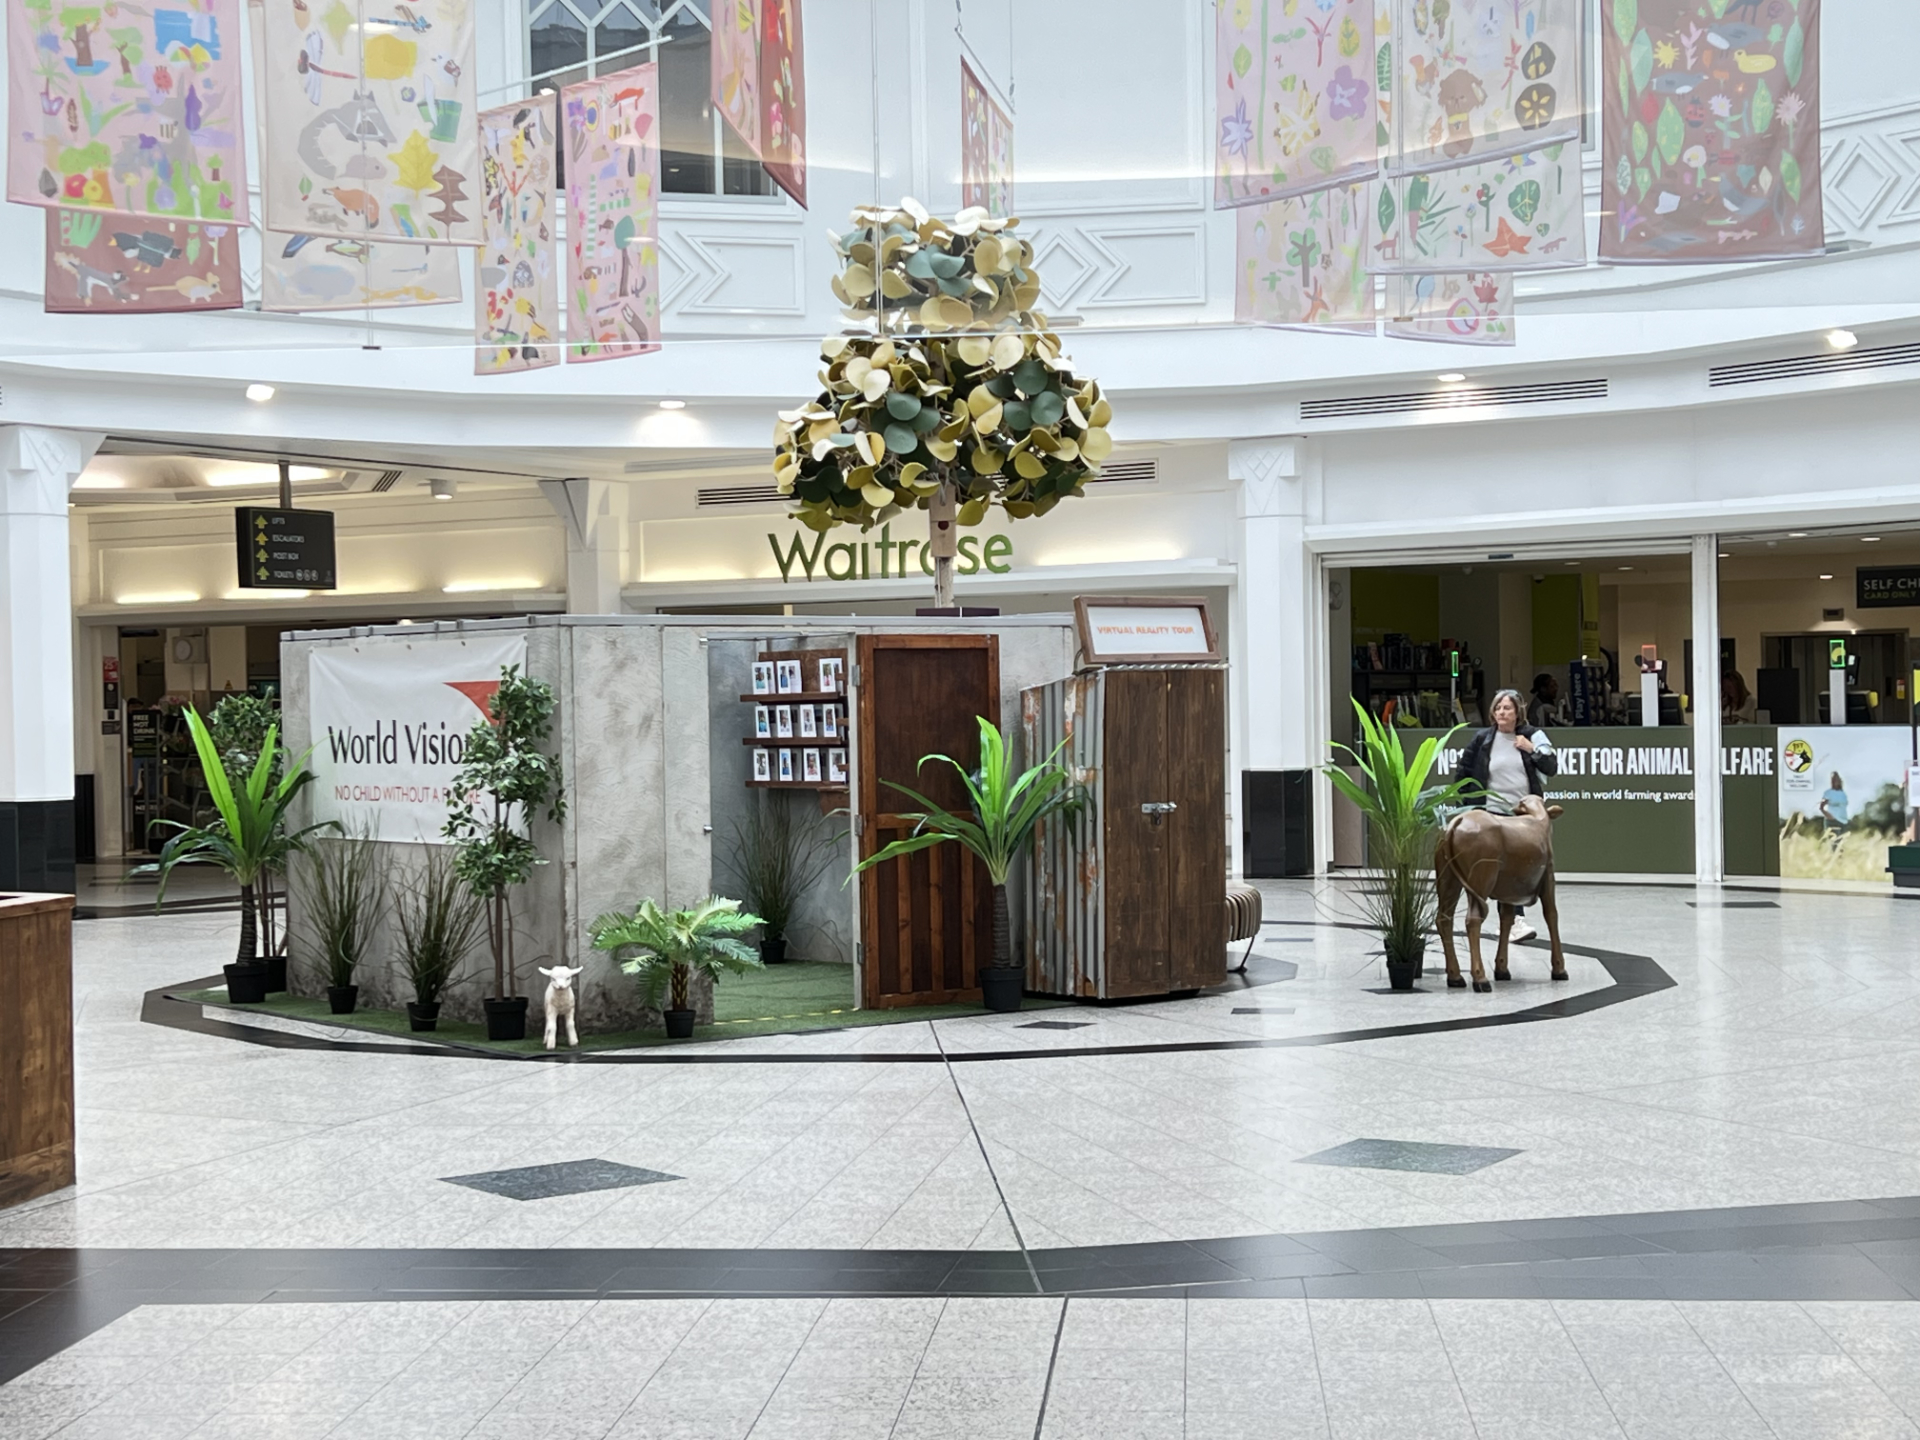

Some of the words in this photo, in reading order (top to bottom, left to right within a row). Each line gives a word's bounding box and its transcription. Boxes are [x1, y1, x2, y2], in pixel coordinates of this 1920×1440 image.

[272, 534, 305, 543] ESCALATORS
[273, 551, 288, 560] POST
[288, 552, 299, 560] BOX
[767, 522, 1014, 583] Waitrose
[273, 570, 295, 579] TOILETS
[1864, 580, 1893, 590] SELF
[1096, 625, 1135, 635] VIRTUAL
[1136, 625, 1170, 635] REALITY
[1171, 625, 1196, 635] TOUR
[328, 720, 397, 764] World
[1591, 747, 1623, 775] FOR
[1626, 747, 1693, 775] ANIMAL
[1720, 747, 1773, 775] LFARE
[335, 785, 351, 801] NO
[353, 785, 381, 801] CHILD
[383, 786, 430, 803] WITHOUT
[432, 787, 440, 803] A
[1543, 790, 1580, 803] passion
[1581, 789, 1591, 800] in
[1593, 789, 1622, 800] world
[1624, 789, 1662, 803] farming
[1663, 789, 1695, 800] award
